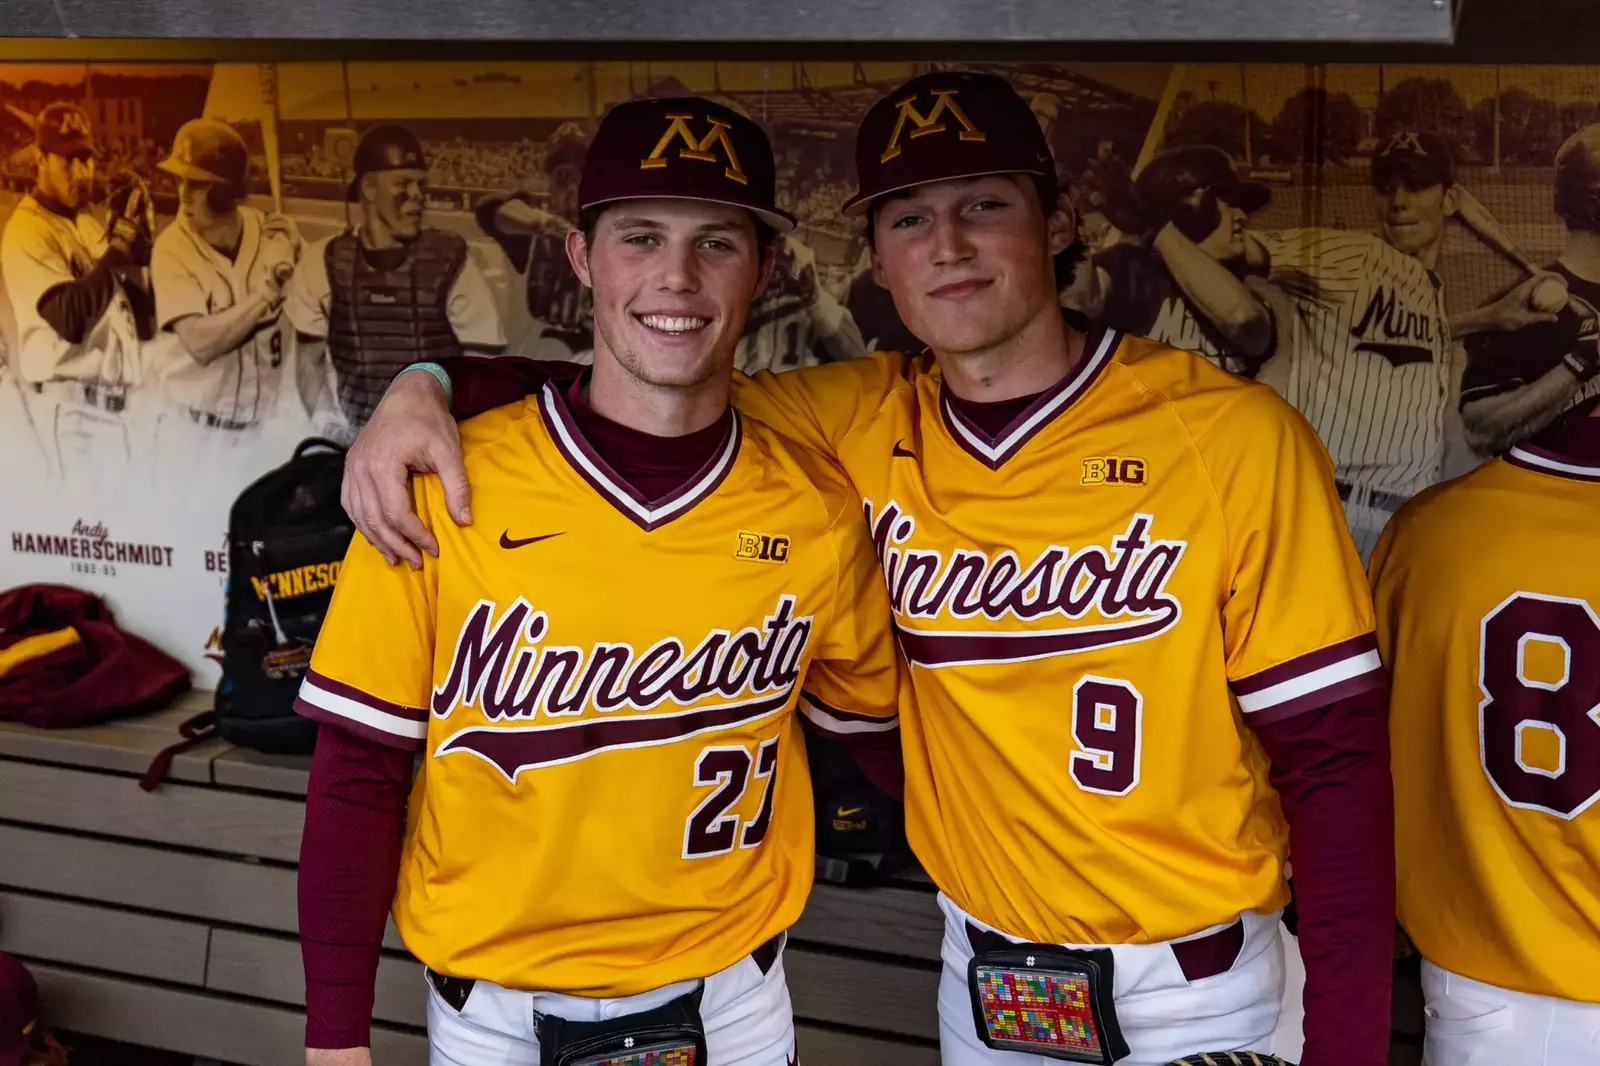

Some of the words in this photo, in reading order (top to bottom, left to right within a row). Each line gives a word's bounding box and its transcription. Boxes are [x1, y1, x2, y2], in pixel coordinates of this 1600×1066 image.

[640, 112, 748, 186] M
[880, 88, 987, 164] M
[11, 530, 174, 568] HAMMERSCHMIDT
[71, 517, 109, 544] Andy
[430, 594, 814, 722] Minnesota
[1477, 590, 1600, 821] 8
[1068, 673, 1144, 797] 9
[681, 732, 780, 860] 27
